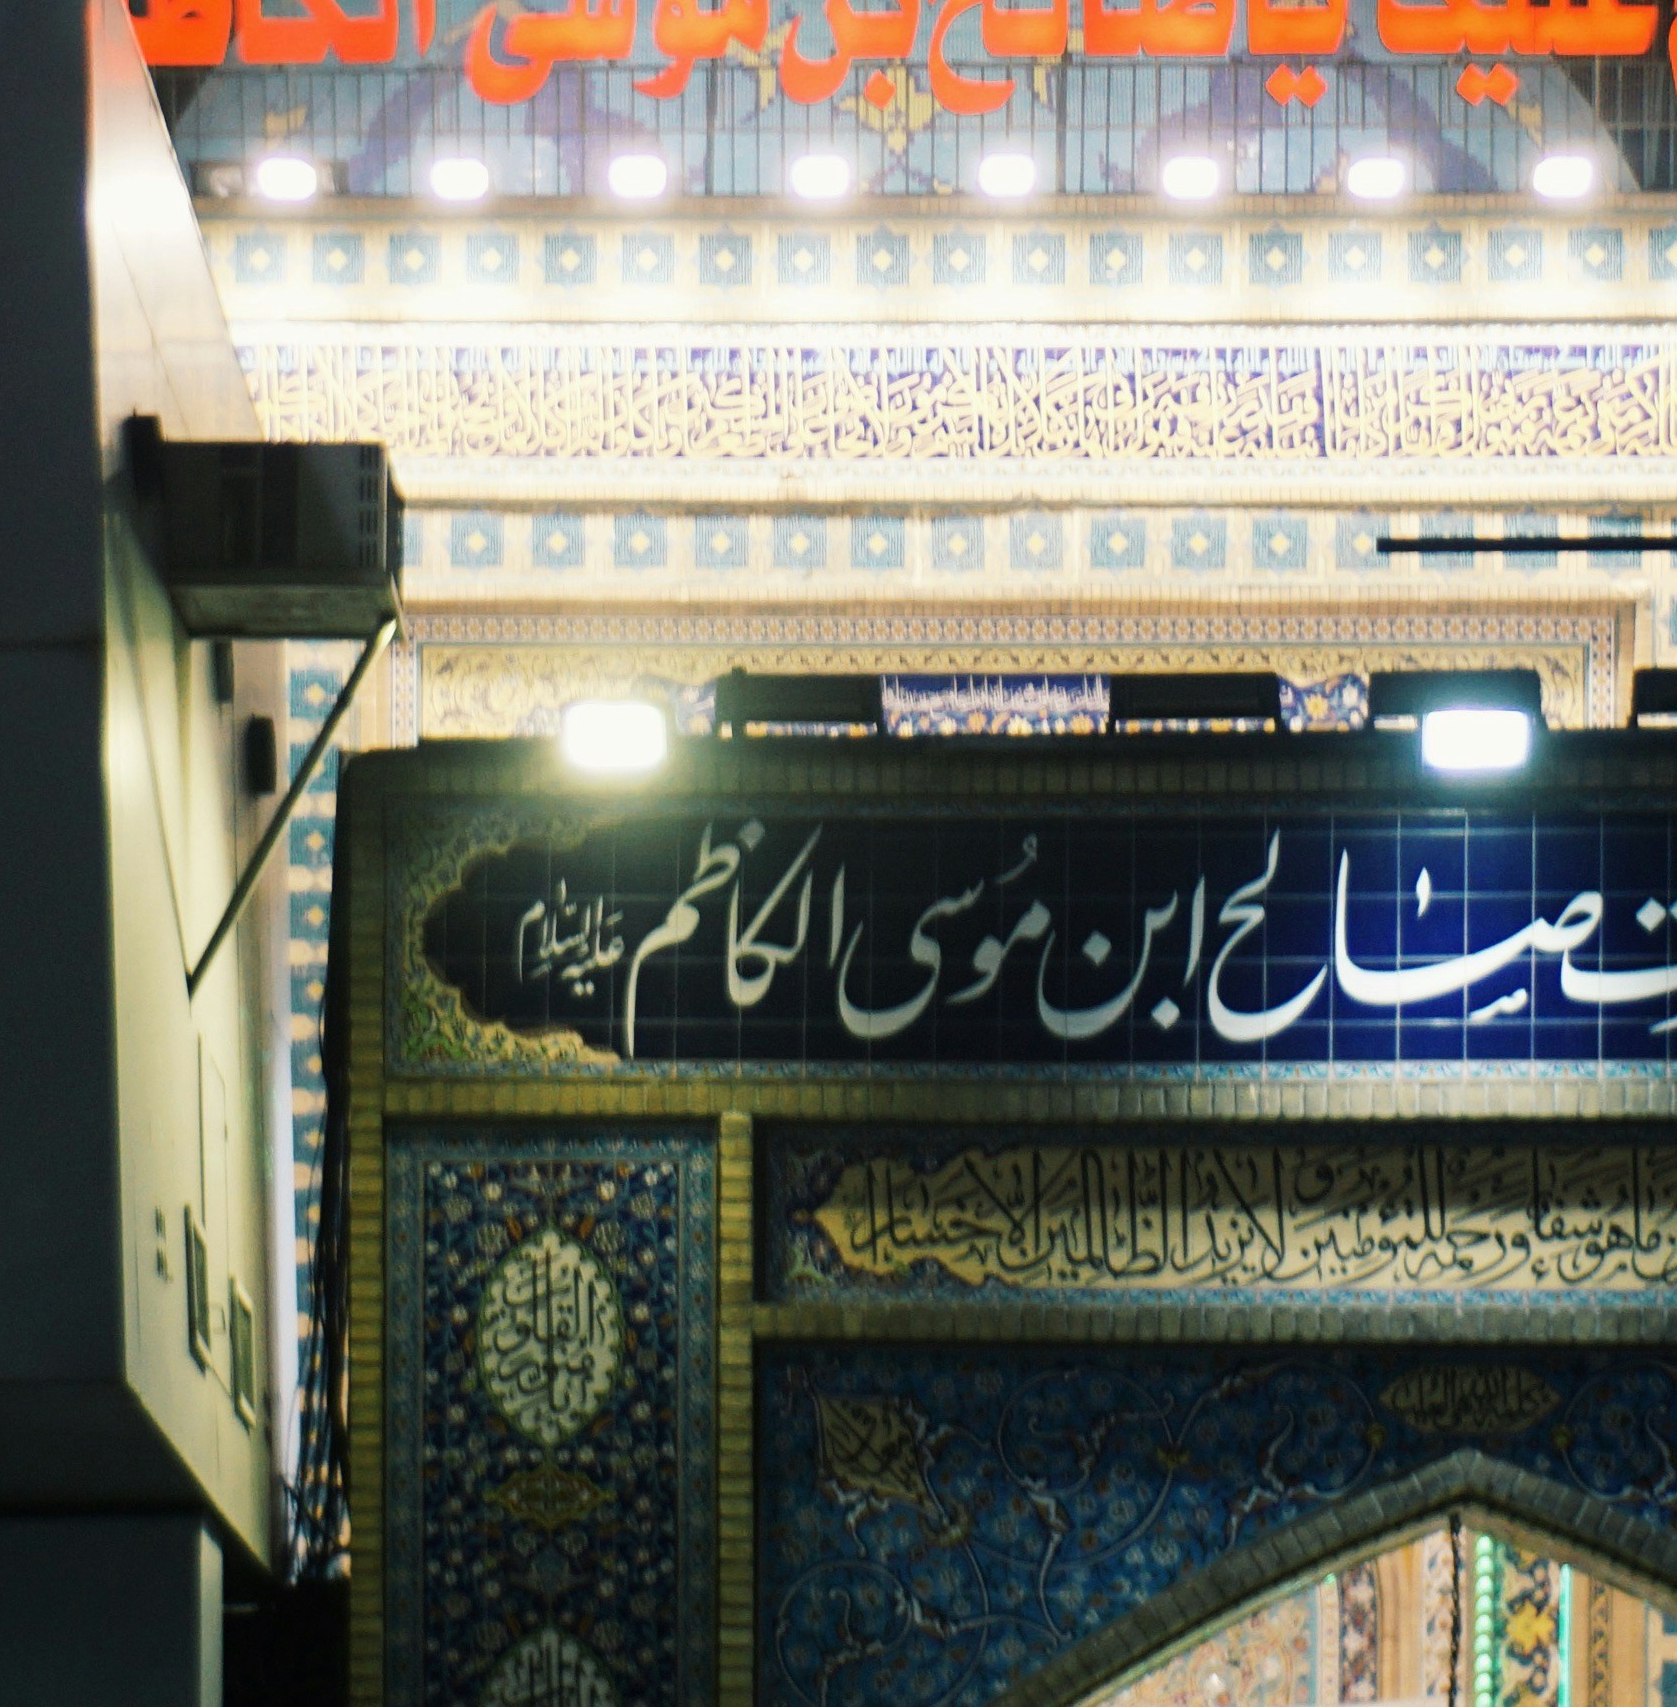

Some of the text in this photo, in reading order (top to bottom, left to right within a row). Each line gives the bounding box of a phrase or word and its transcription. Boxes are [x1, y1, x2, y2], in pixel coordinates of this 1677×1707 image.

[626, 819, 845, 1060] الکاظم
[839, 878, 1050, 1040] موسی
[1036, 875, 1205, 1040] ابن
[1208, 828, 1603, 1045] صالح
